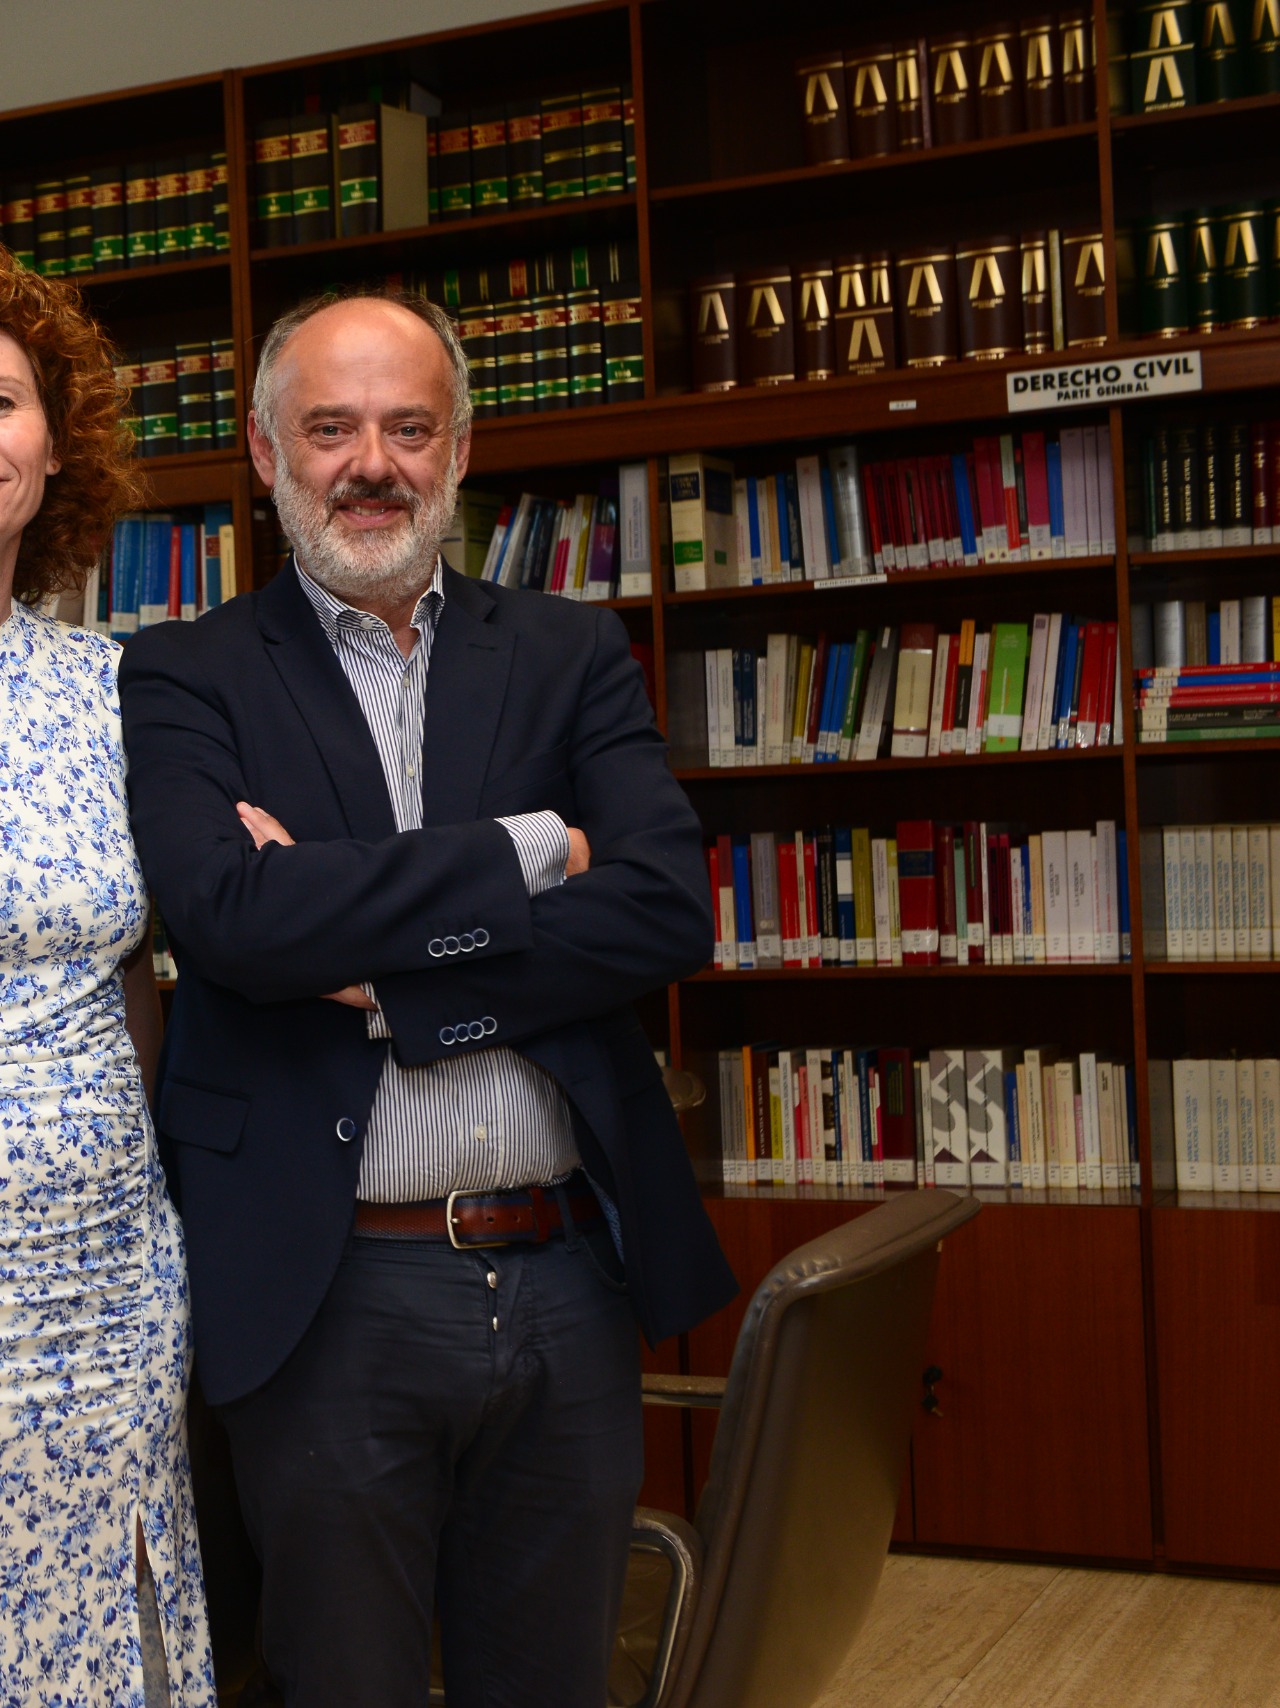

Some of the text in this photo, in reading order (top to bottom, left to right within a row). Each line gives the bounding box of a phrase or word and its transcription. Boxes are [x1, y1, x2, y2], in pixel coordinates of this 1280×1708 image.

[1013, 357, 1194, 394] DERECHO CIVIL
[1057, 382, 1149, 401] PARTE GENERAL
